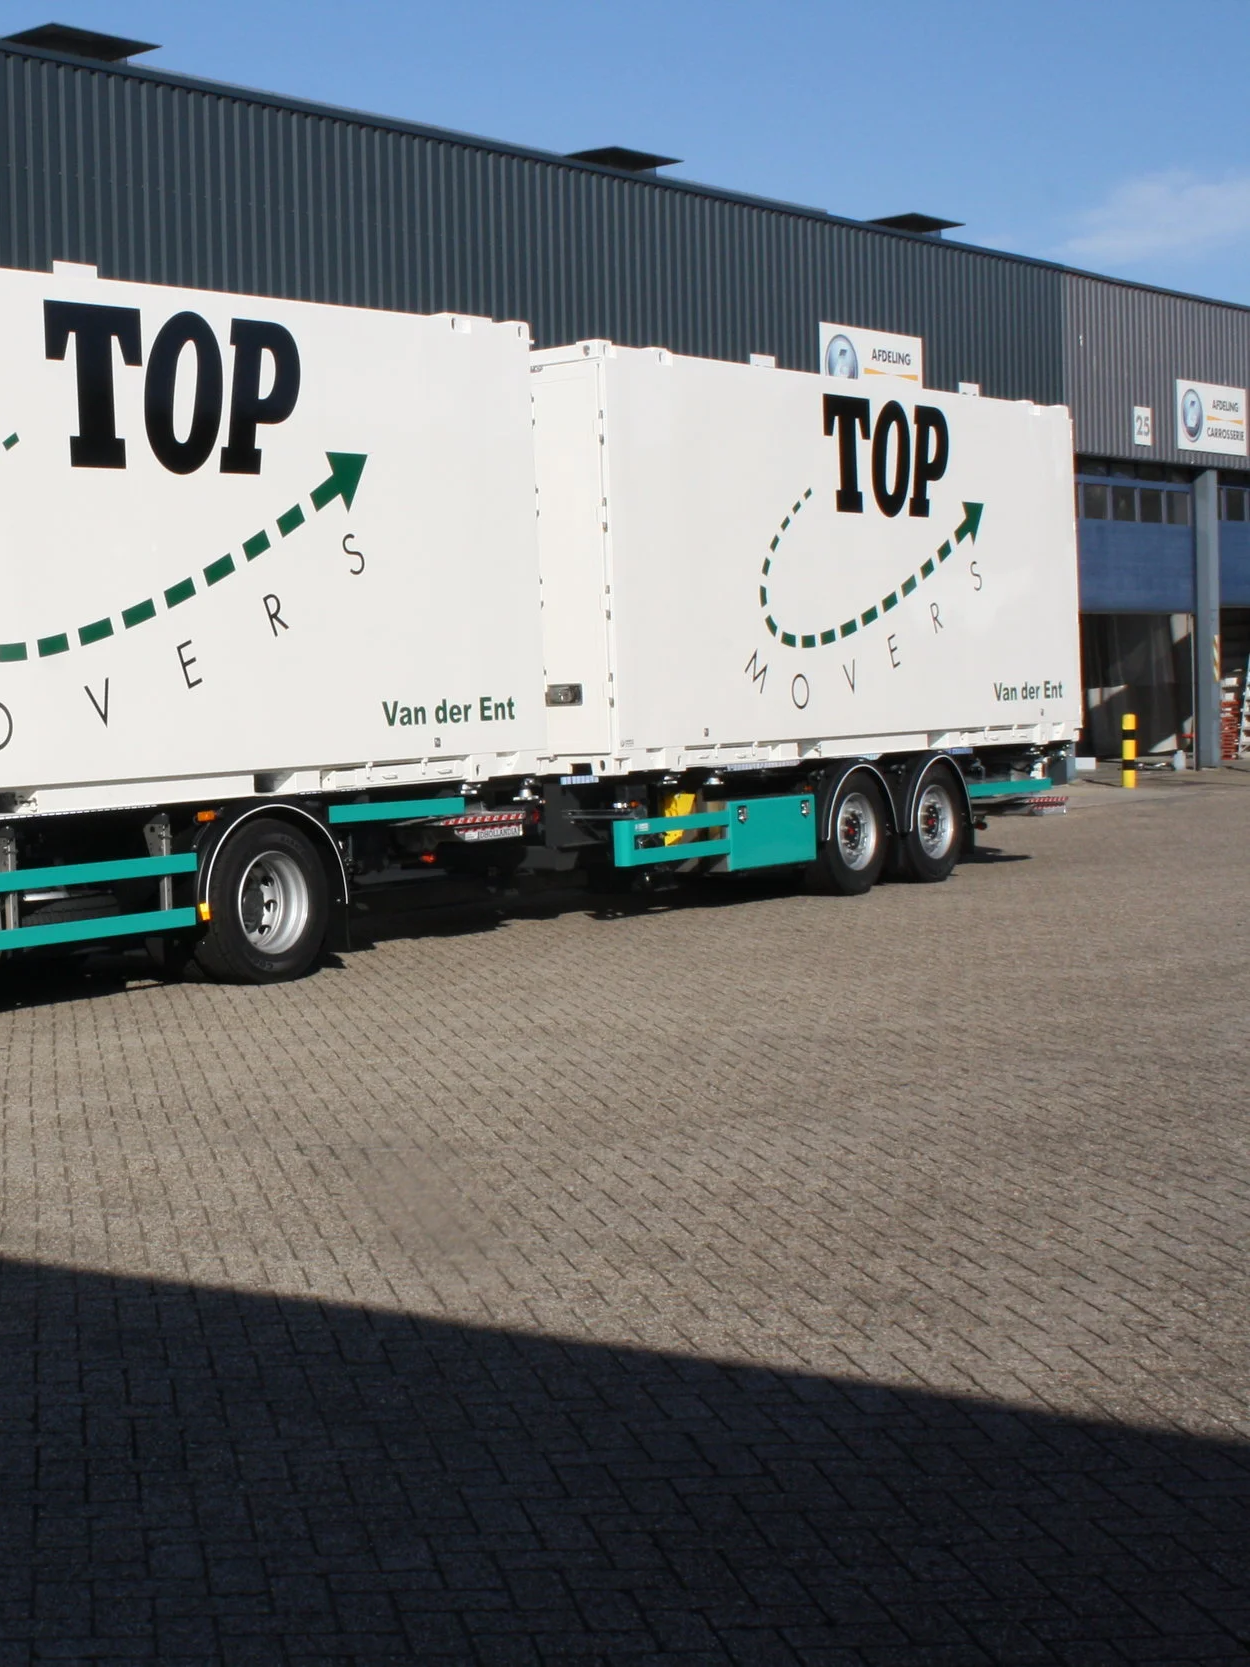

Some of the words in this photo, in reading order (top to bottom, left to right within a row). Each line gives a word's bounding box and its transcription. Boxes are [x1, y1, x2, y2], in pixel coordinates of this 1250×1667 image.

[871, 348, 912, 366] AFDELING
[43, 298, 301, 476] TOP
[1211, 399, 1239, 413] AFDELING
[1135, 415, 1150, 437] 25
[1206, 427, 1245, 442] CARROSSERIE
[822, 393, 950, 518] TOP
[744, 560, 983, 710] MOVERS
[993, 682, 1018, 702] Van
[1021, 681, 1041, 700] der
[1043, 680, 1063, 699] Ent
[382, 700, 427, 727] Van
[434, 698, 472, 724] der
[479, 695, 516, 722] Ent
